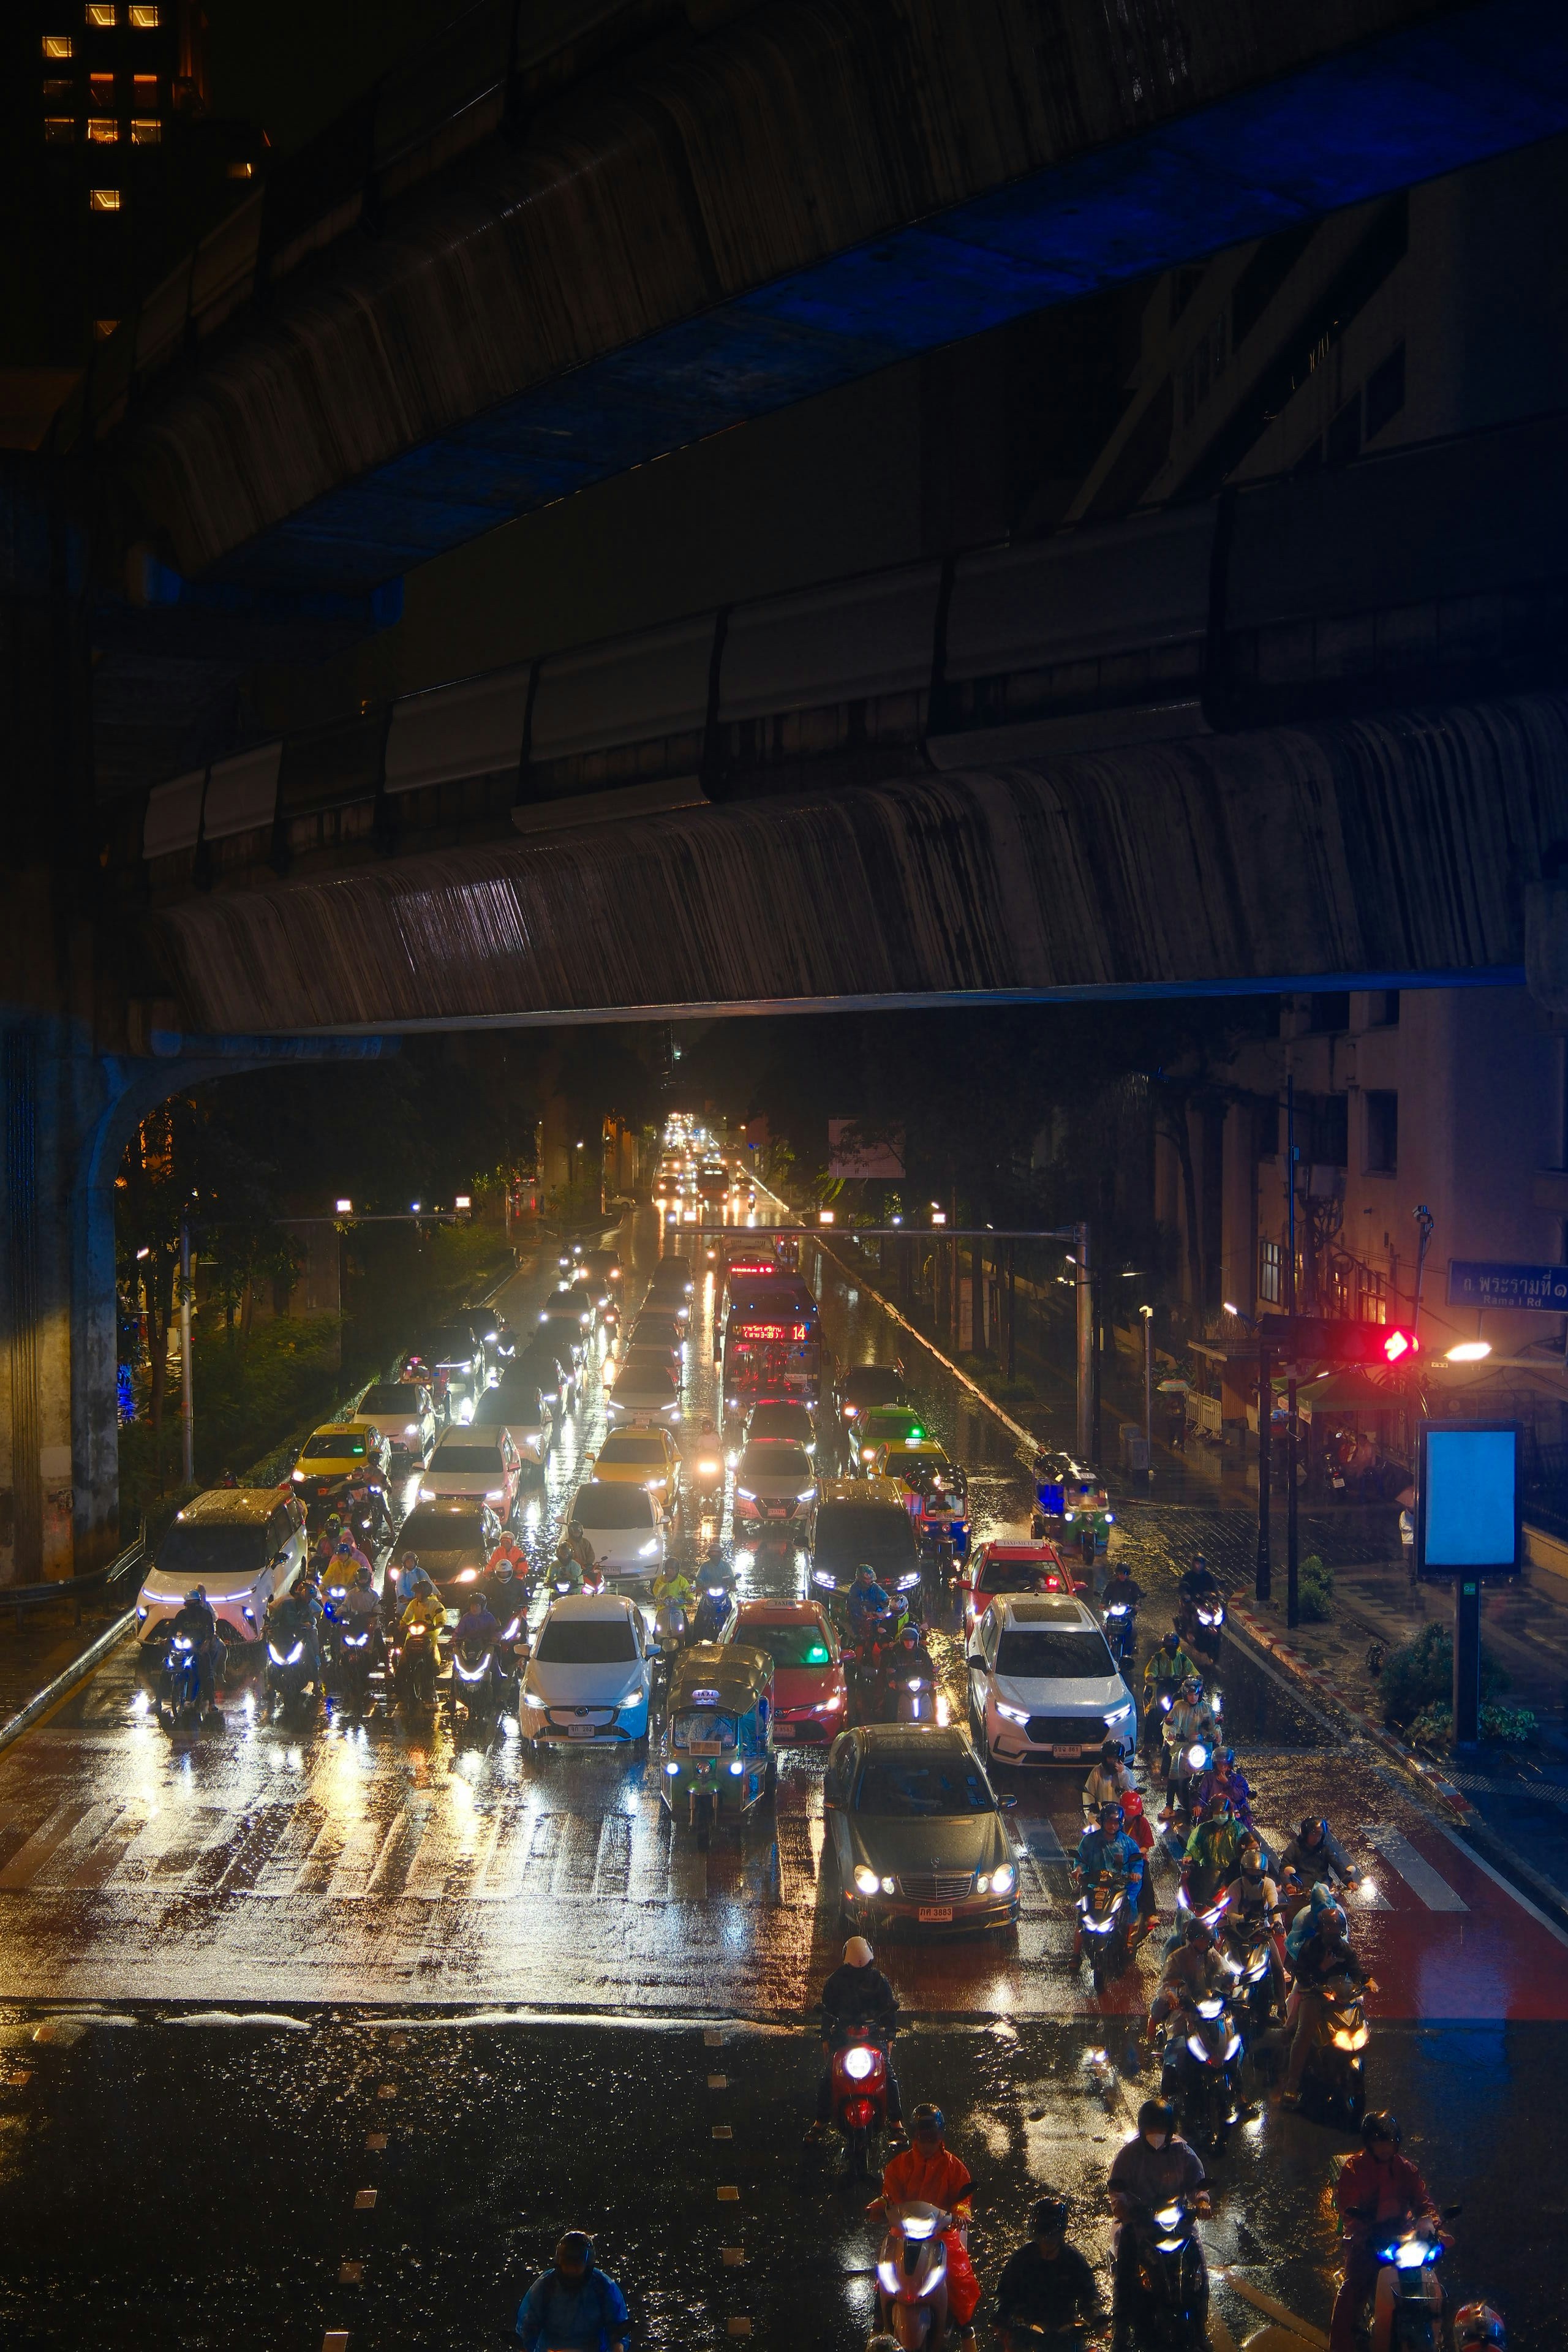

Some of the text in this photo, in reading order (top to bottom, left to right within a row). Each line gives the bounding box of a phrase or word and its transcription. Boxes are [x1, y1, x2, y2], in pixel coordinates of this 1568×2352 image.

[1483, 1295, 1515, 1306] Rama
[1527, 1298, 1544, 1308] Rd.
[793, 1326, 805, 1340] 14
[933, 1908, 951, 1917] 3883
